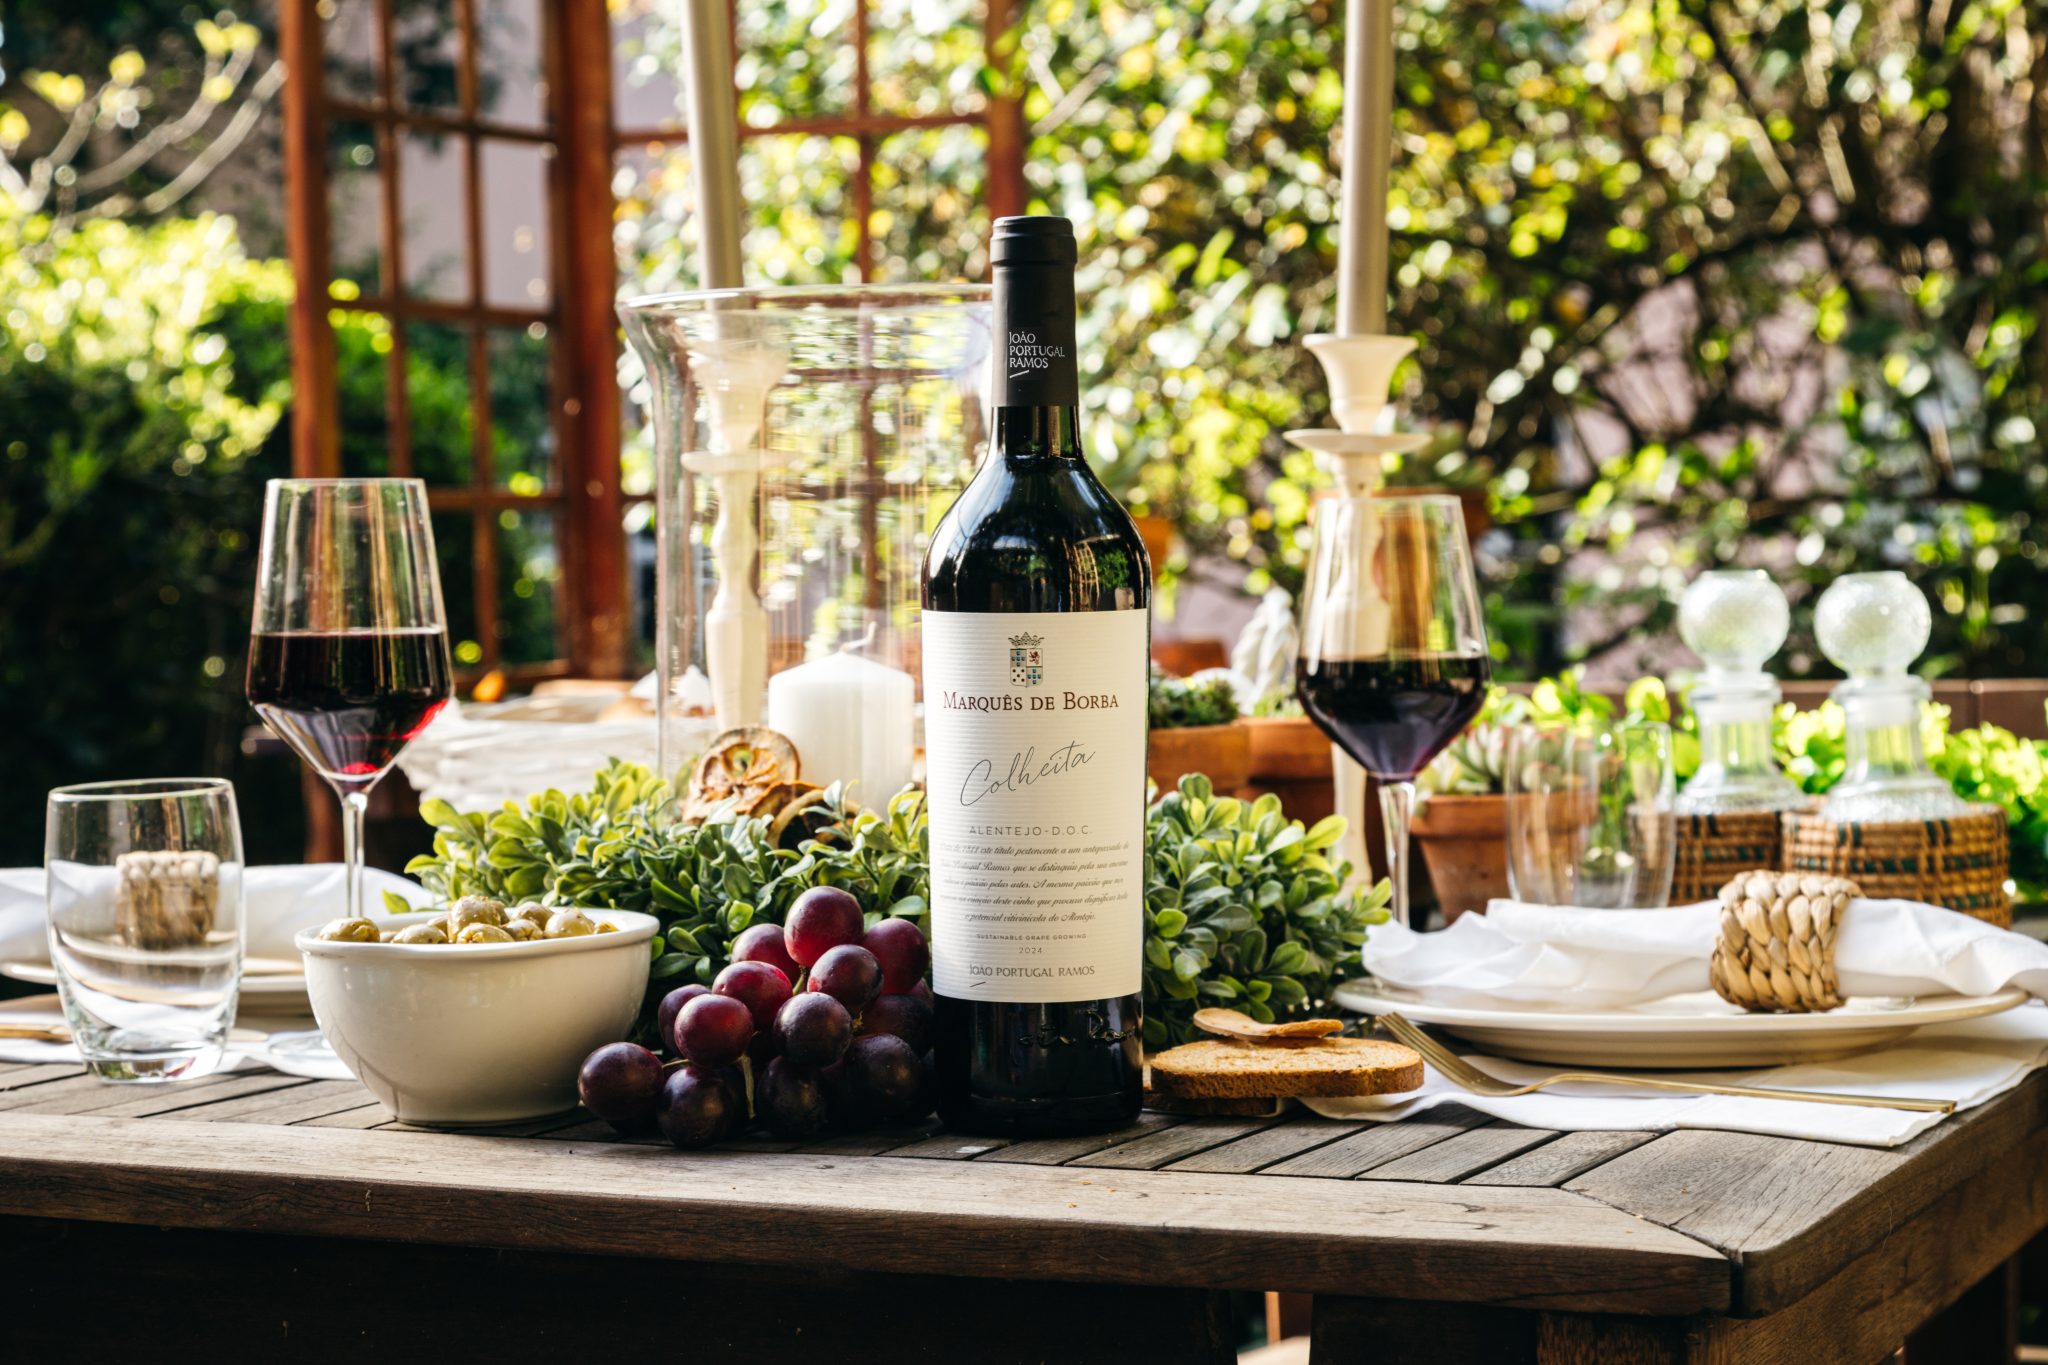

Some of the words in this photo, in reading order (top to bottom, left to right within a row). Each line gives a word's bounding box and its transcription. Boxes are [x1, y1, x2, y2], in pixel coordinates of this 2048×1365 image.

[1008, 330, 1035, 345] JOÃO
[1009, 345, 1065, 357] PORTUGAL
[1009, 357, 1049, 368] RAMOS
[959, 740, 1096, 806] Colheita
[976, 933, 1023, 941] SUSTAINABLE
[1052, 933, 1087, 941] GROWING
[996, 966, 1054, 977] PORTUGAL
[1058, 965, 1095, 976] RAMOS
